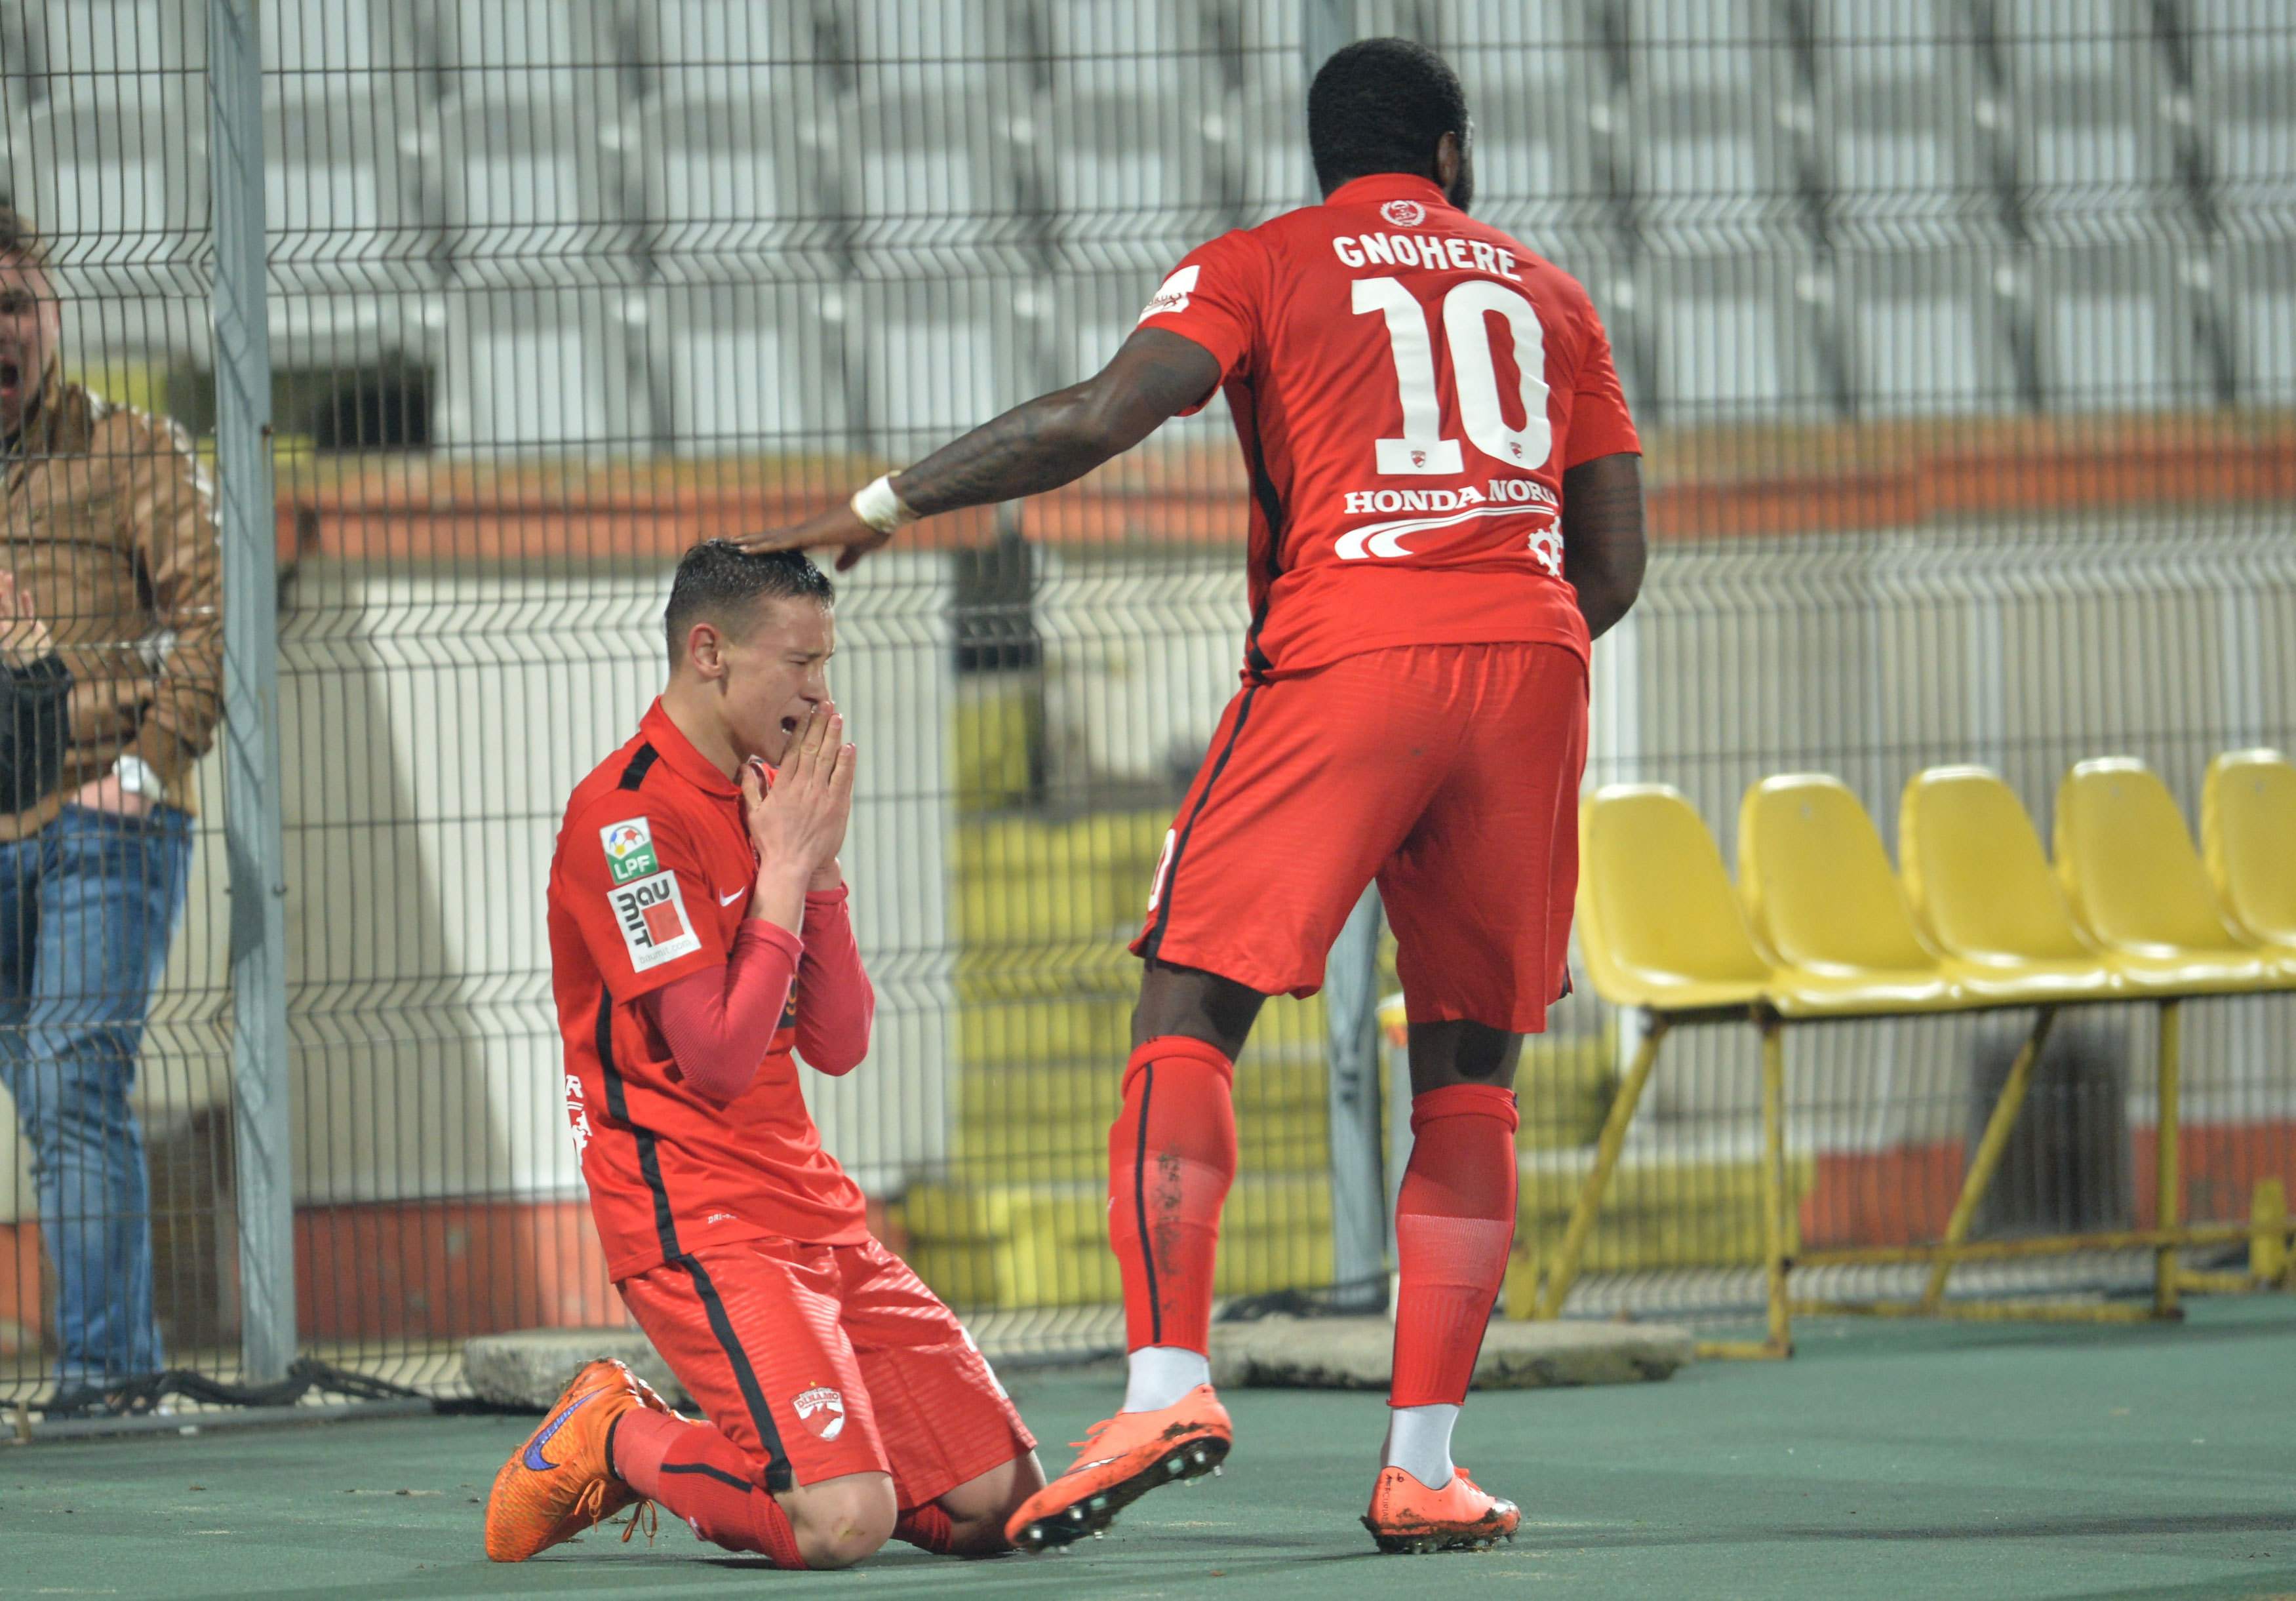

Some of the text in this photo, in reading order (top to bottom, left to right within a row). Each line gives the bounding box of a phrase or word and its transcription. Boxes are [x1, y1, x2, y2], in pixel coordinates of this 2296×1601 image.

[1332, 232, 1522, 281] GNOHERE
[1351, 277, 1552, 475] 10
[1344, 486, 1485, 513] HONDA
[614, 855, 650, 879] LPF
